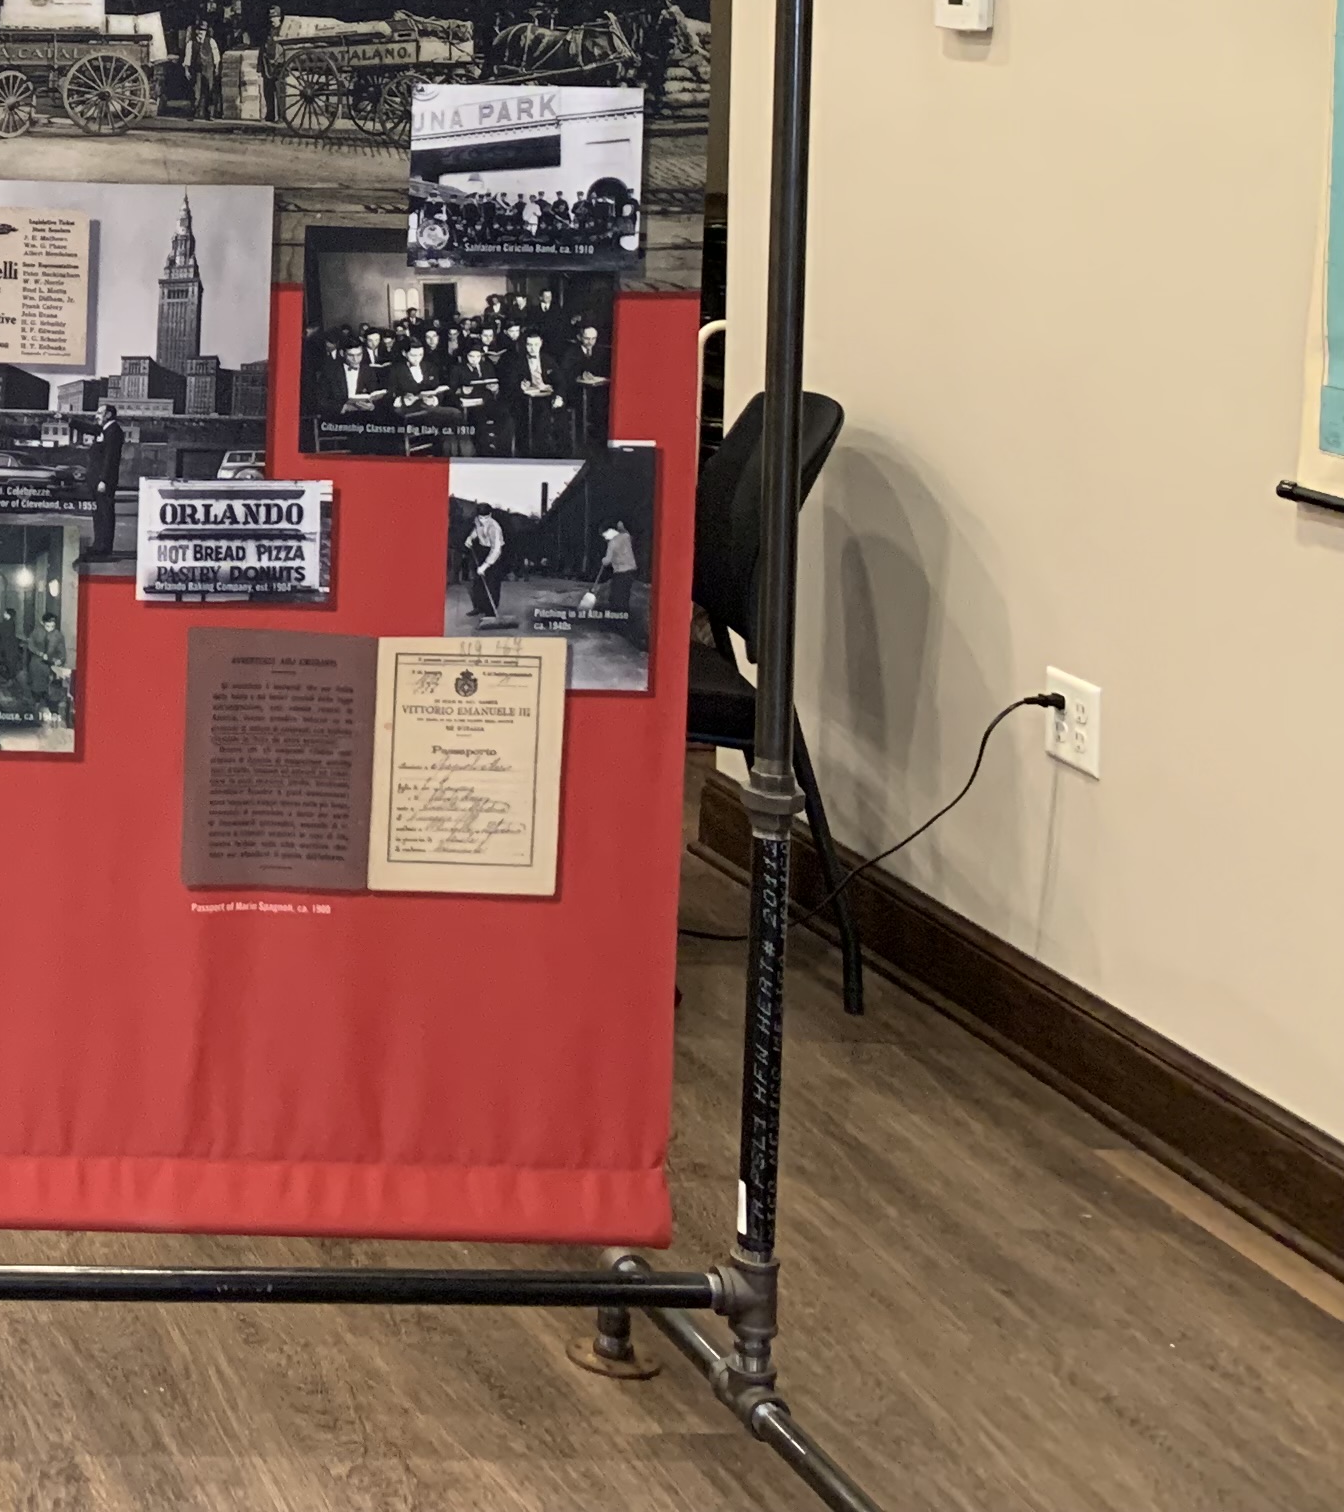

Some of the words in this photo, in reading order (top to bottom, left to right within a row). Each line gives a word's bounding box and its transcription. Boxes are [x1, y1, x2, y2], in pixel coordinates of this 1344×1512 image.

[478, 93, 557, 126] PARK
[465, 242, 502, 253] Salvatore
[559, 246, 572, 254] ca.
[574, 245, 595, 255] 1910
[321, 423, 364, 434] Citizenship
[366, 423, 395, 434] Classes
[398, 425, 405, 434] in
[407, 425, 420, 436] Big
[442, 427, 454, 435] ca.
[457, 426, 475, 436] 1910
[11, 498, 19, 507] of
[21, 498, 61, 510] Cleveland,
[63, 501, 75, 510] ca.
[78, 500, 98, 511] 1955
[160, 503, 304, 526] ORLANDO
[157, 544, 190, 563] HOT
[193, 544, 246, 562] BREAD
[257, 545, 305, 562] PIZZA
[157, 566, 222, 583] PASTRY
[230, 566, 306, 583] DONUTS
[155, 581, 187, 592] Orlando
[188, 582, 215, 593] Baking
[534, 608, 567, 620] Pitching
[588, 610, 603, 620] Alta
[604, 610, 629, 620] House
[534, 623, 546, 631] ca.
[548, 621, 572, 631] 1940s
[402, 704, 454, 716] VITTORIO
[456, 705, 517, 717] EMANUELE
[431, 745, 497, 757] Passaporto
[191, 902, 226, 913] Passport
[226, 902, 235, 911] of
[236, 902, 258, 912] Mario
[756, 939, 776, 1035] HEAT#
